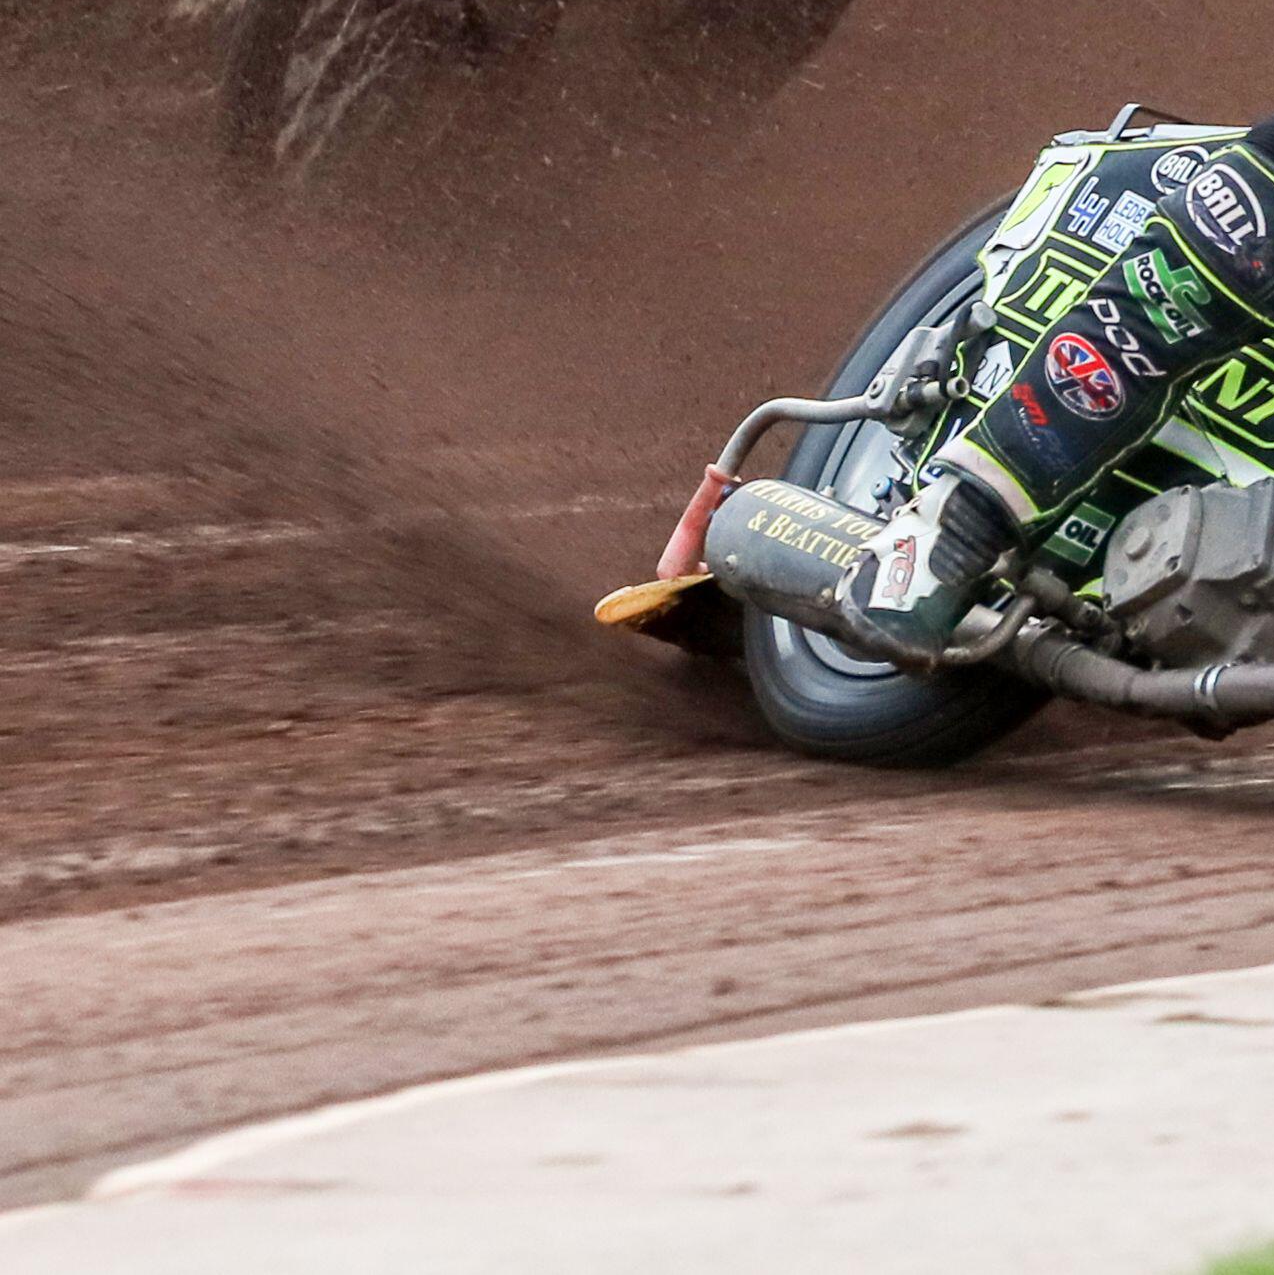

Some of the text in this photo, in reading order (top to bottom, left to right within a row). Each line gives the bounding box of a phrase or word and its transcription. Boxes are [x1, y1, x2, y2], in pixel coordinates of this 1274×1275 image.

[1197, 171, 1255, 247] BALL
[748, 482, 827, 522] HARRIS
[747, 509, 862, 571] & BEATTIE
[1064, 520, 1099, 548] OIL
